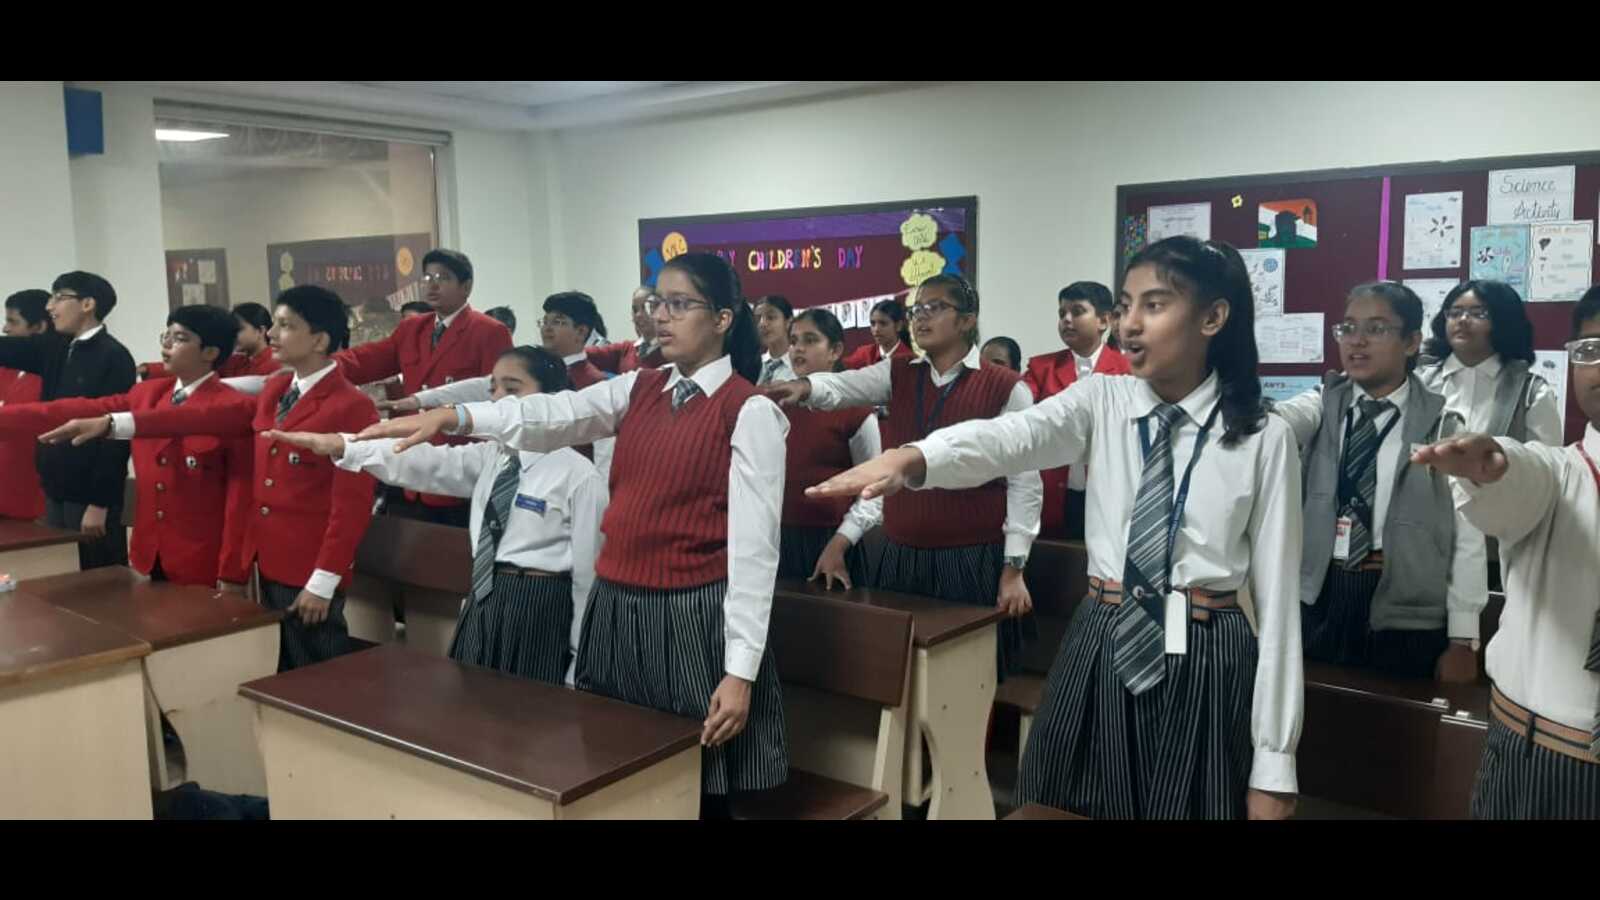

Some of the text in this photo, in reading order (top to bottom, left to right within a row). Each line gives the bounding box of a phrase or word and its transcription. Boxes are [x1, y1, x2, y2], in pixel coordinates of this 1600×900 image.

[1500, 174, 1557, 194] Science
[1513, 198, 1561, 221] Activity
[747, 245, 822, 271] CHILDREN'S
[838, 245, 864, 269] DAY
